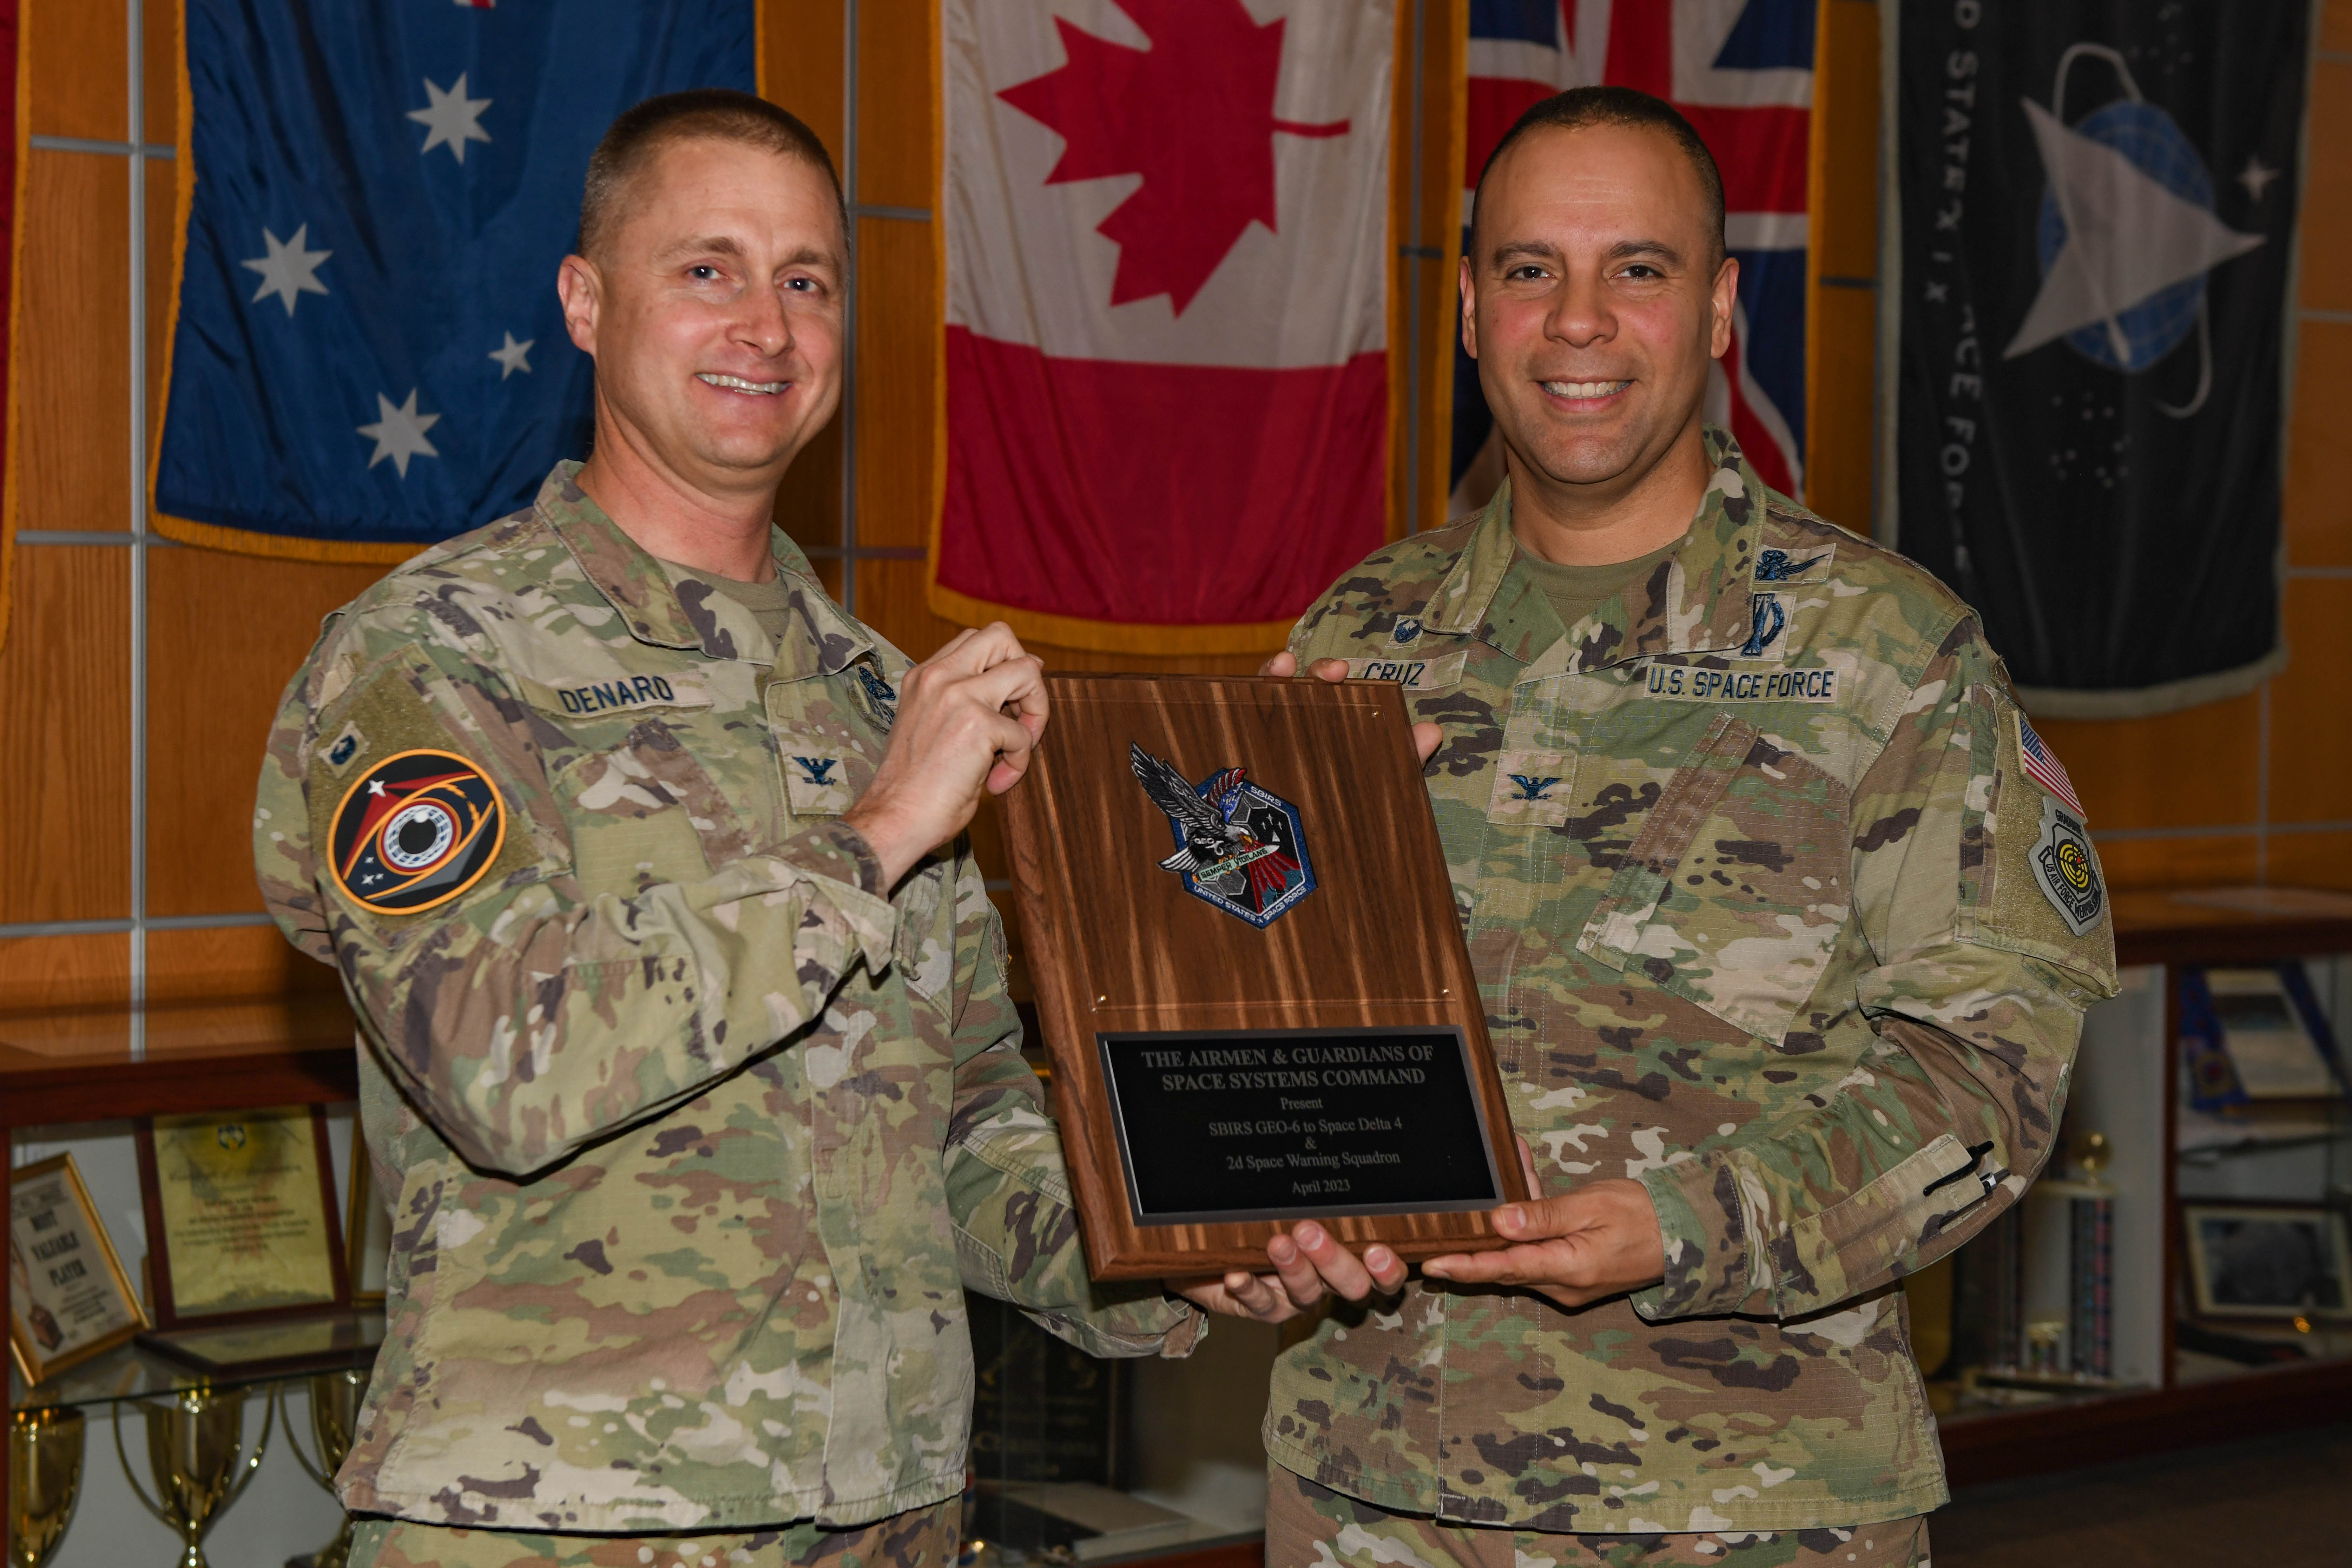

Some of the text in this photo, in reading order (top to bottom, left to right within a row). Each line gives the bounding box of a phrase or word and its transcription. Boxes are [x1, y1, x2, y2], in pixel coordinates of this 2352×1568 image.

[1364, 663, 1425, 686] CRUZ
[1650, 668, 1834, 698] U.S. SPACE FORCE
[558, 676, 674, 713] DENARO
[1251, 786, 1282, 806] SBIRS
[1201, 847, 1268, 878] SEMPER VIGILANS
[2045, 863, 2055, 872] US
[2049, 874, 2061, 886] AIR
[1194, 885, 1256, 922] UNITED STATES
[1263, 885, 1307, 921] SPACE FORCE
[2057, 883, 2075, 908] FORCE
[1141, 1045, 1433, 1068] THE AIRMEN & GUARDIANS OF
[1162, 1068, 1425, 1091] SPACE SYSTEMS COMMAND
[1280, 1097, 1323, 1110] Present
[1209, 1117, 1402, 1136] SBIRS GEO-6 to Space Delta 4
[1305, 1137, 1317, 1149] &
[1226, 1151, 1401, 1172] 2d Space Warning Squadron
[1292, 1179, 1350, 1196] April 2023
